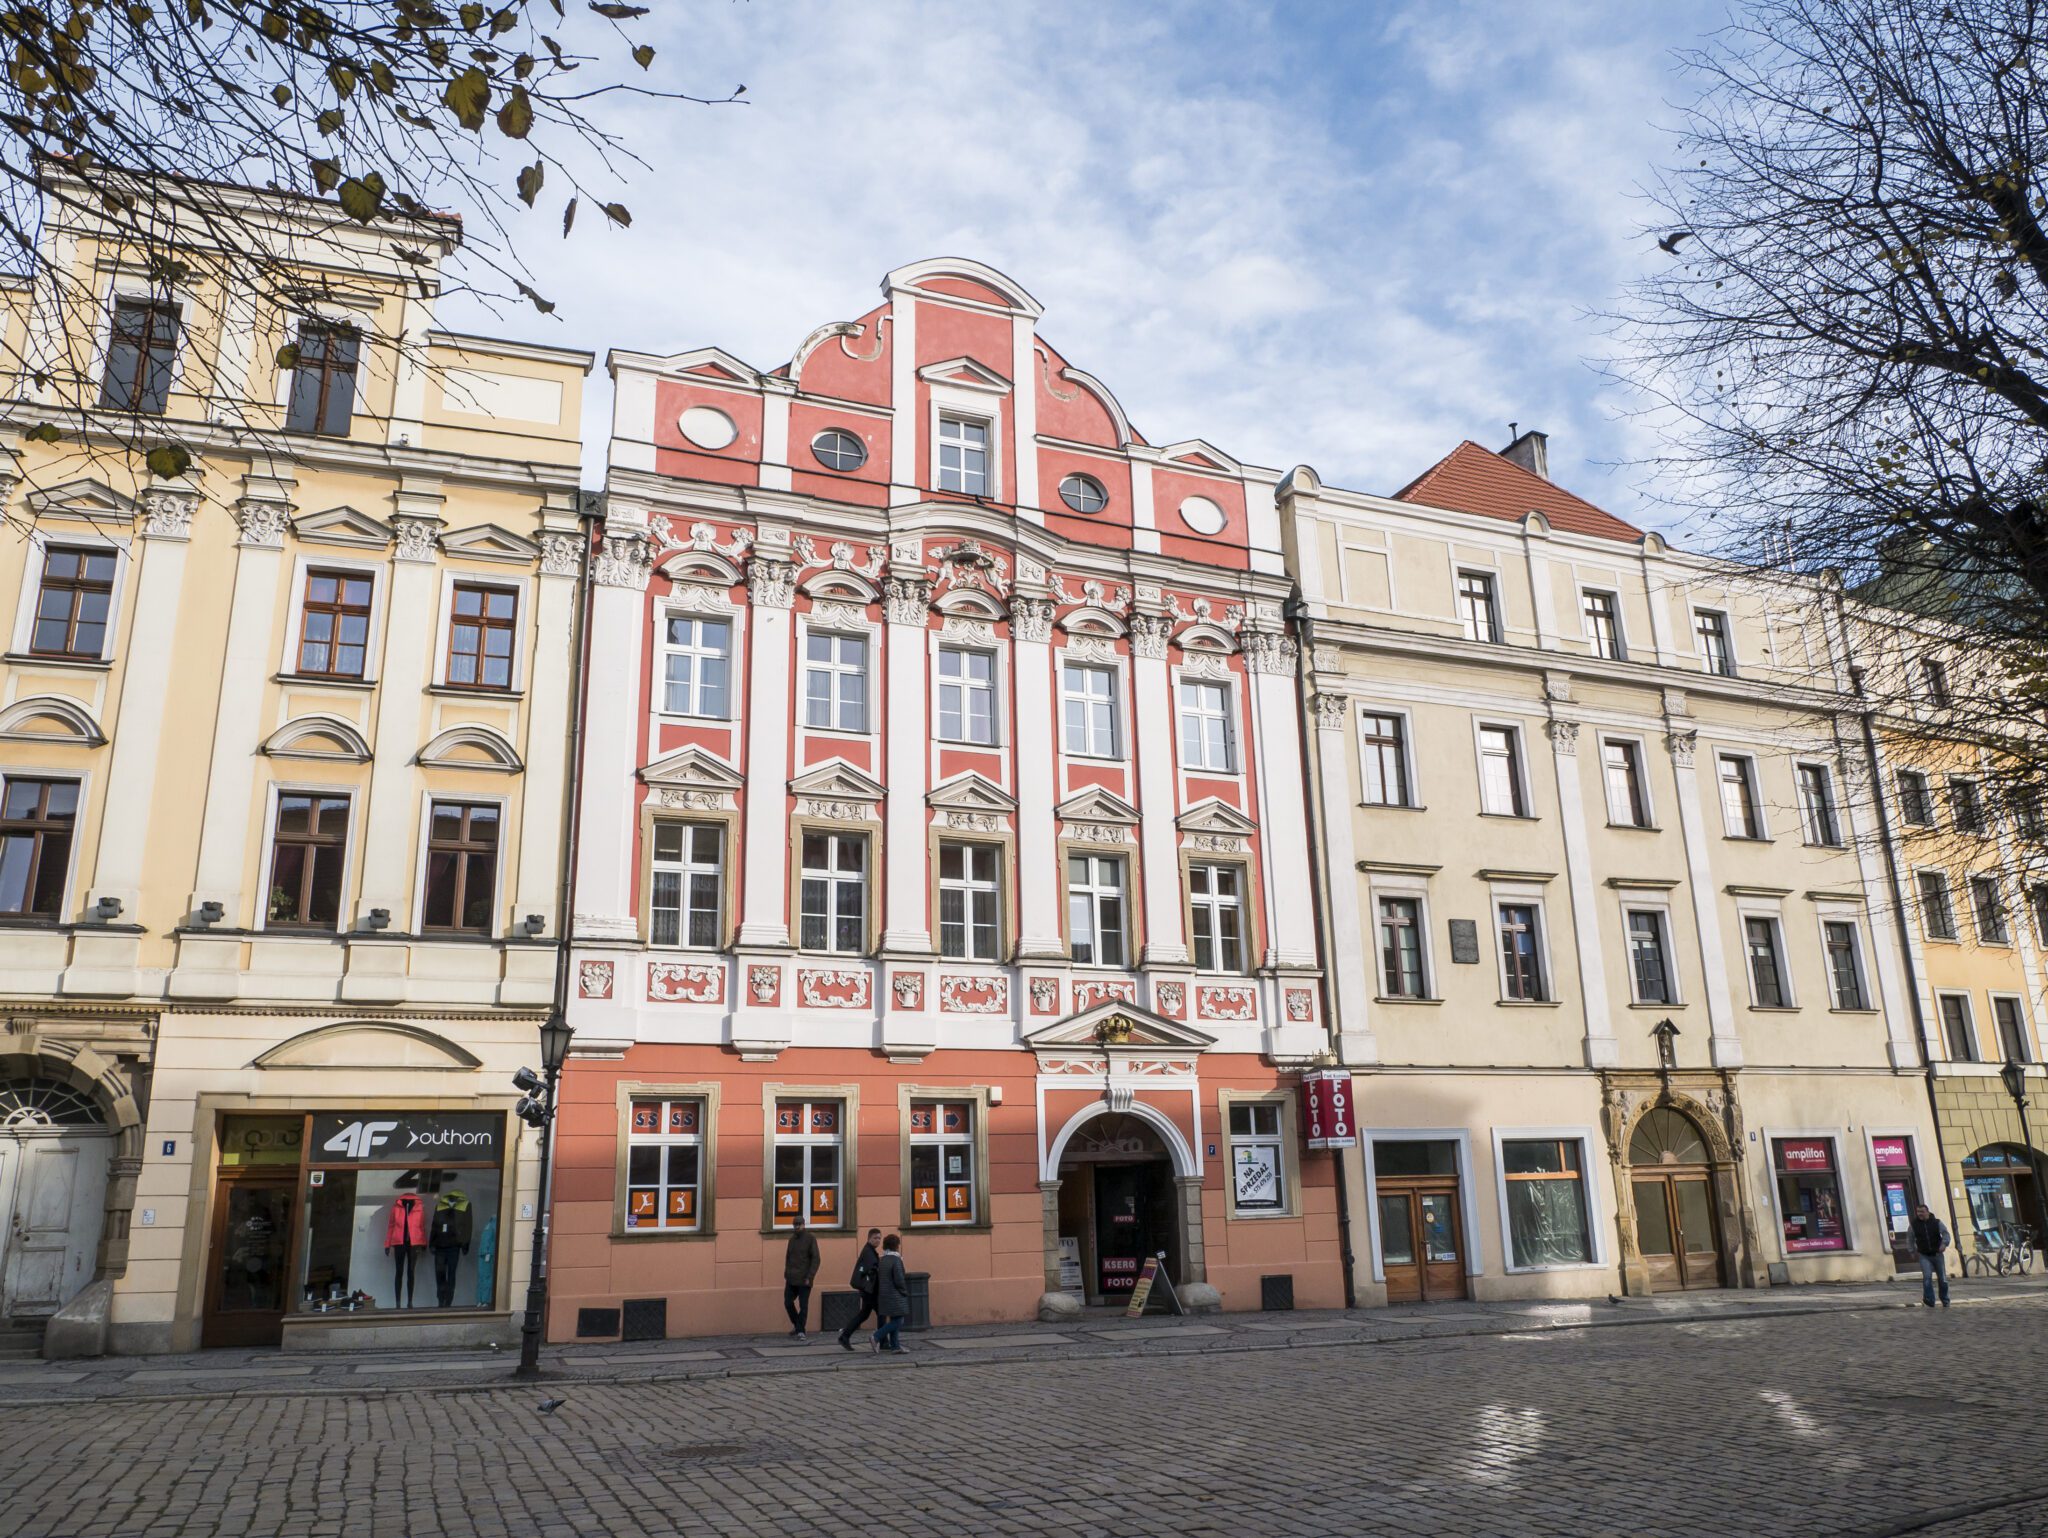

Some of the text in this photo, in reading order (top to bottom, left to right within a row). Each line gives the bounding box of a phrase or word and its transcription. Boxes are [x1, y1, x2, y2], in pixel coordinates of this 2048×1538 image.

[1309, 1081, 1321, 1137] FOTO
[1333, 1079, 1348, 1136] FOTO
[324, 1121, 398, 1157] 4F
[419, 1129, 492, 1145] outhorn
[166, 1142, 172, 1153] 6
[1786, 1147, 1825, 1161] amplifon
[1875, 1146, 1902, 1156] amplifon
[1240, 1162, 1270, 1195] SPRZEDAŻ
[1243, 1166, 1255, 1178] NA
[1104, 1260, 1135, 1269] KSERO
[1107, 1278, 1134, 1287] FOTO
